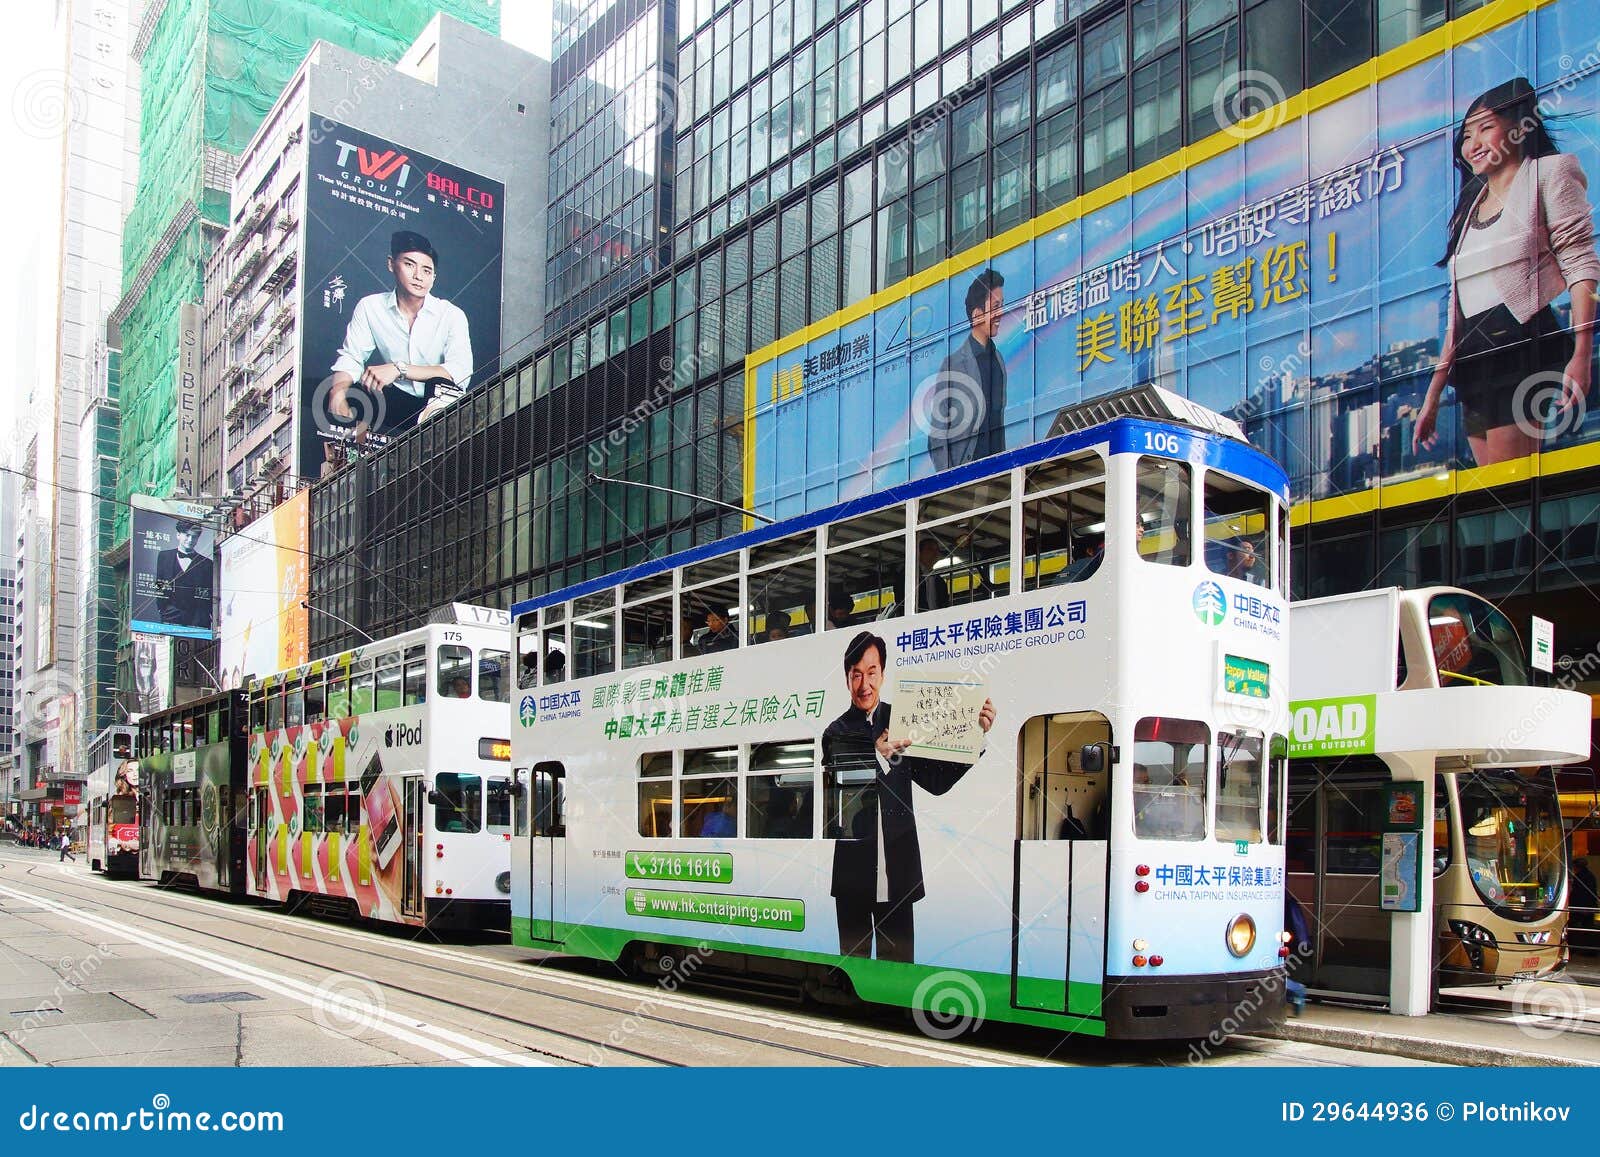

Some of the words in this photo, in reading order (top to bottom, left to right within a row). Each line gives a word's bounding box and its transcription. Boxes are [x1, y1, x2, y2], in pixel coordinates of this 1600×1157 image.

[317, 173, 335, 185] Time
[336, 179, 357, 192] Watch
[358, 187, 395, 205] Investments
[396, 200, 420, 214] Limited
[341, 171, 402, 197] GROUP
[427, 172, 493, 209] BALCO
[181, 328, 196, 498] SIBERIAN
[1144, 431, 1179, 453] 106
[471, 607, 510, 627] 175
[896, 600, 1087, 653] 中國太平保險集團公司
[1234, 617, 1257, 631] CHINA
[443, 631, 462, 641] 175
[896, 654, 924, 667] CHINA
[925, 648, 961, 664] TAIPING
[964, 637, 1022, 657] INSURANCE
[1025, 631, 1065, 648] GROUP
[592, 665, 724, 710] 國際影星成龍推薦
[539, 690, 581, 711] 中国太平
[540, 713, 556, 722] CHINA
[559, 709, 581, 720] TAIPING
[604, 689, 826, 741] 中國太平為首選之保險公司
[1288, 704, 1367, 742] OAD
[396, 720, 422, 747] iPod
[1321, 740, 1366, 750] OUTDOOR
[649, 856, 682, 877] 3716
[687, 857, 721, 877] 1616
[1155, 890, 1188, 901] CHINA
[1190, 891, 1224, 901] TAIPING
[1227, 890, 1263, 900] INSURANCE
[651, 897, 793, 922] www.hk.cntaiping.com
